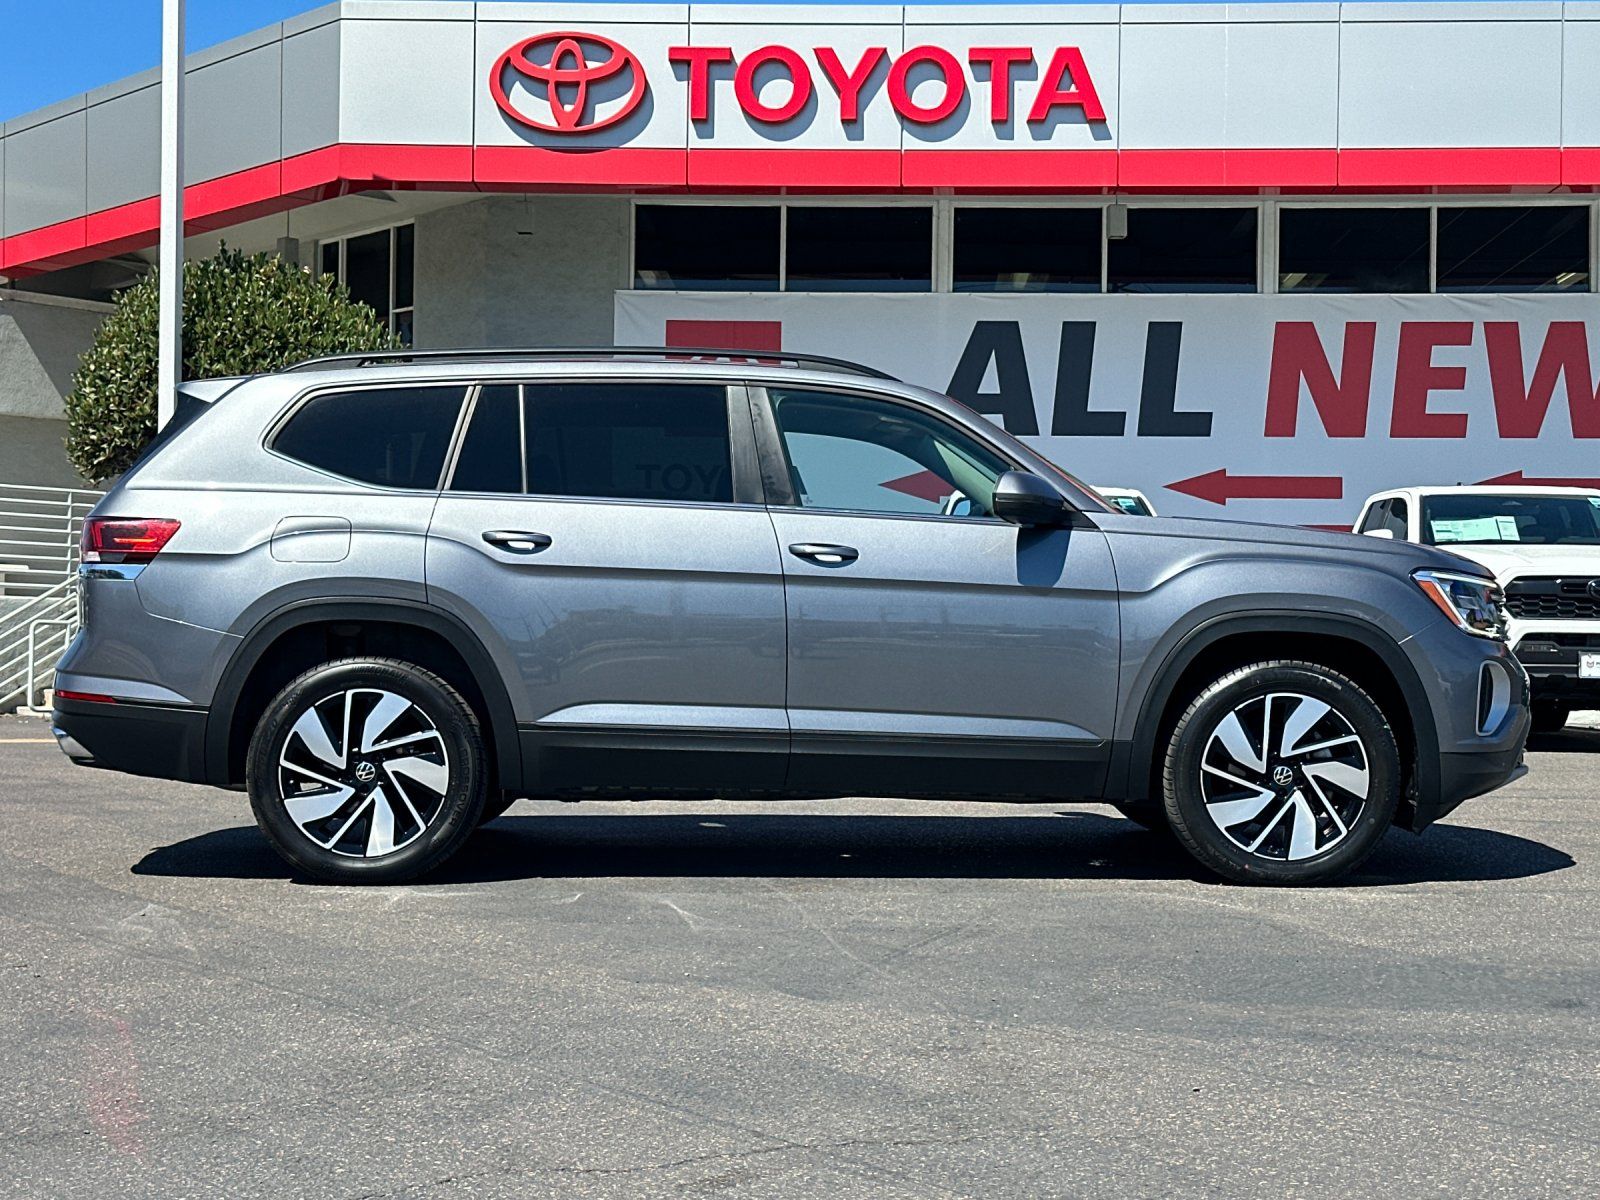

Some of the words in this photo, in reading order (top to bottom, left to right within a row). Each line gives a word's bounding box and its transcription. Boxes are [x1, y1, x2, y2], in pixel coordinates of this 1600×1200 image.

[668, 45, 1106, 123] TOYOTA
[945, 320, 1214, 437] ALL
[1264, 321, 1600, 439] NEW
